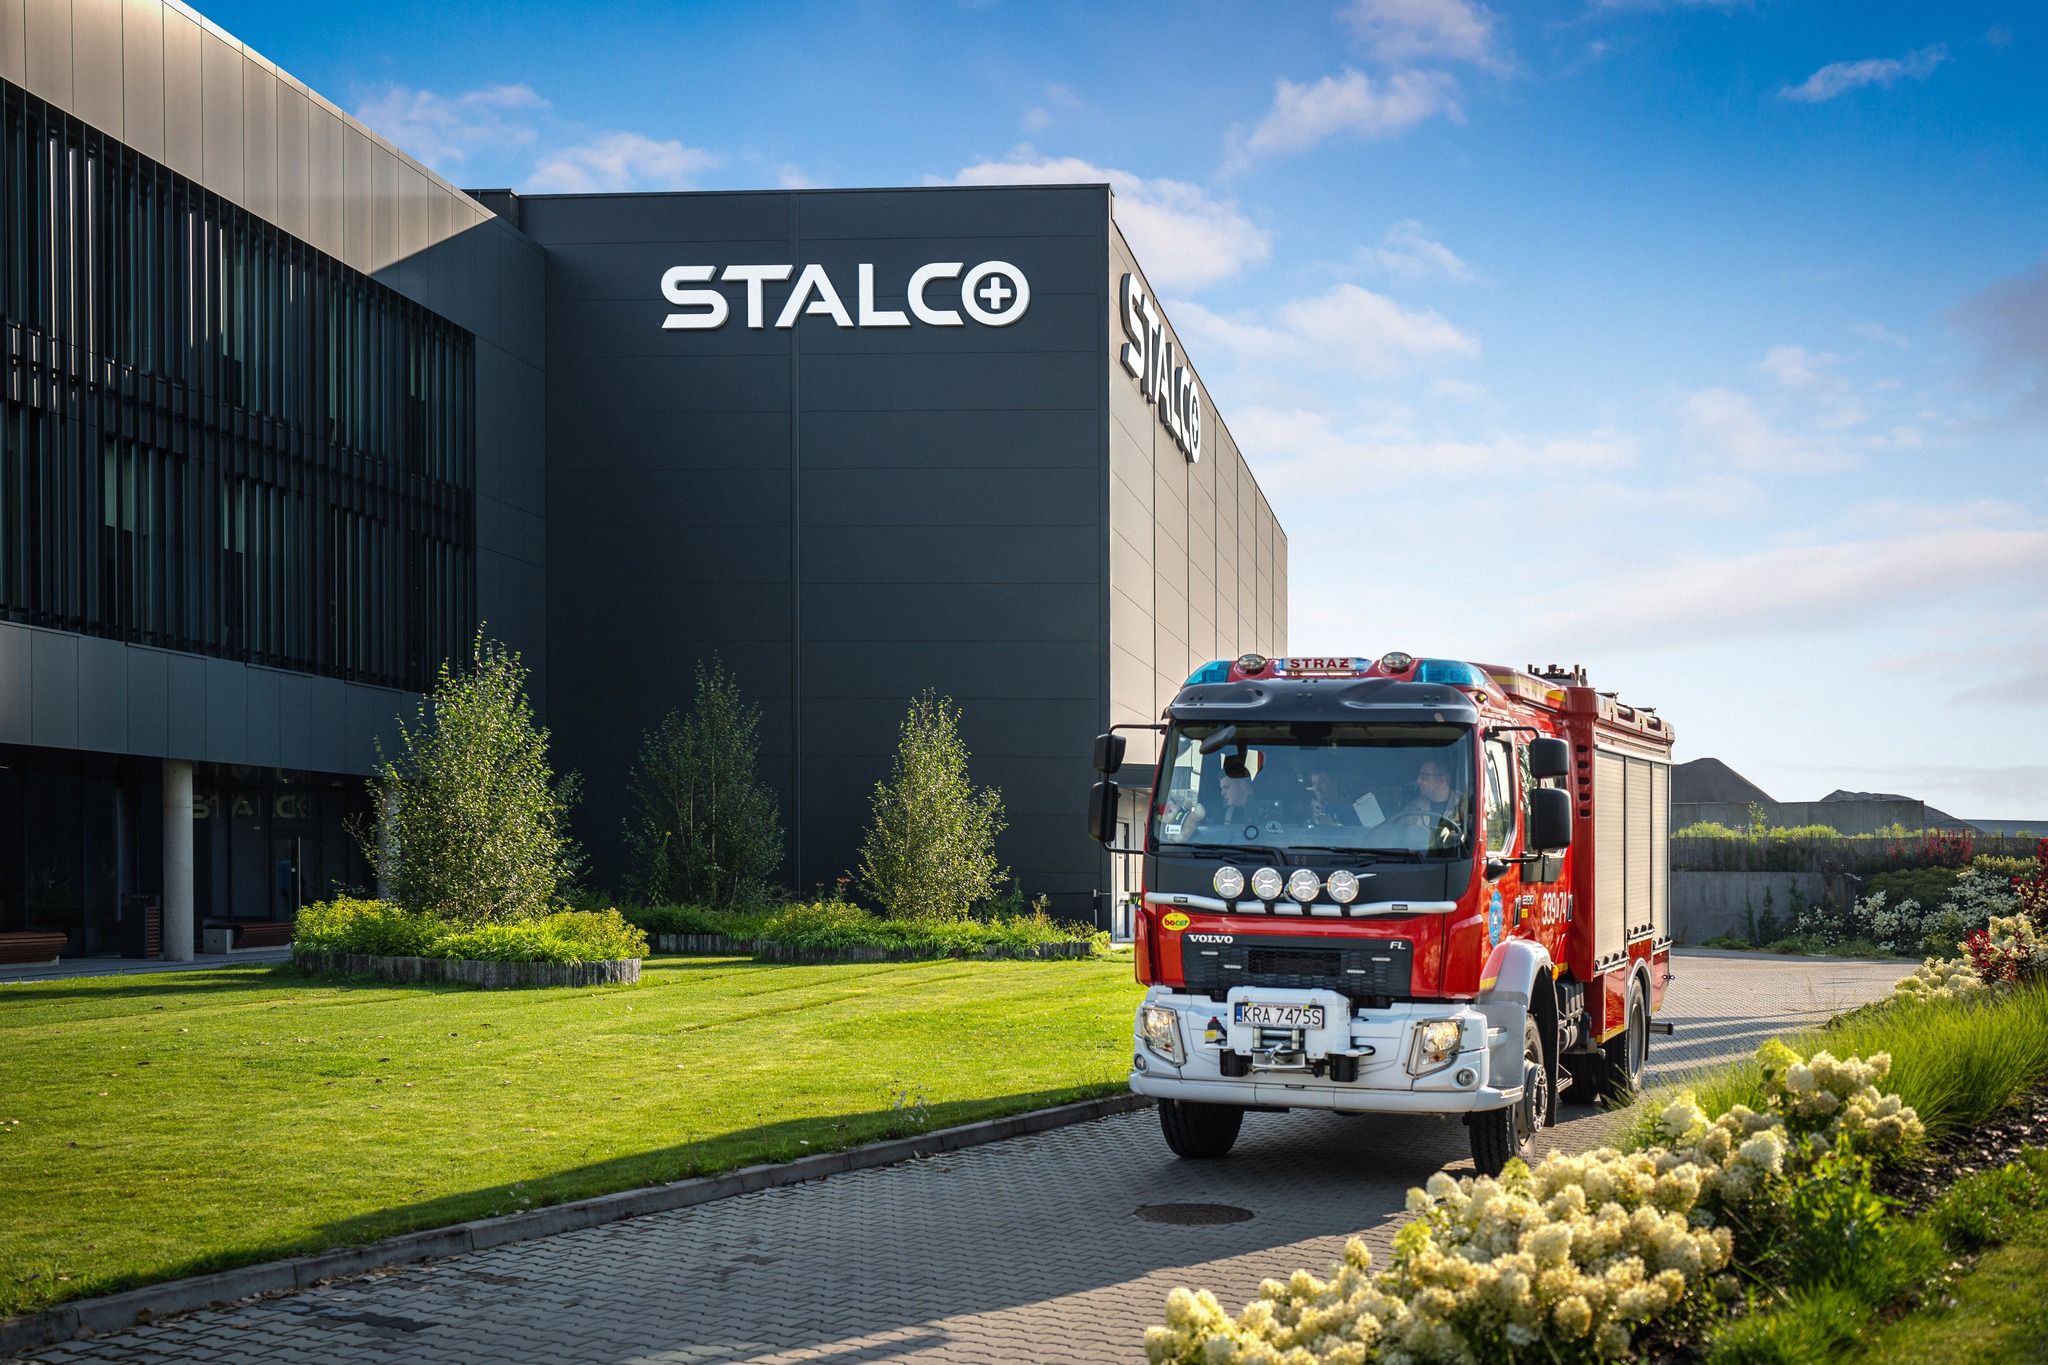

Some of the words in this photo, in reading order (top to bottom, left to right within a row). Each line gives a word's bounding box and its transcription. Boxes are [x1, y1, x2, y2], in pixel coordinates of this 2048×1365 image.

[661, 260, 1031, 330] STALCO
[1120, 272, 1201, 464] STALCO
[1188, 934, 1234, 944] VOLVO
[1389, 941, 1407, 950] FL
[1243, 1006, 1271, 1023] KRA
[1276, 1008, 1321, 1025] 7475S
